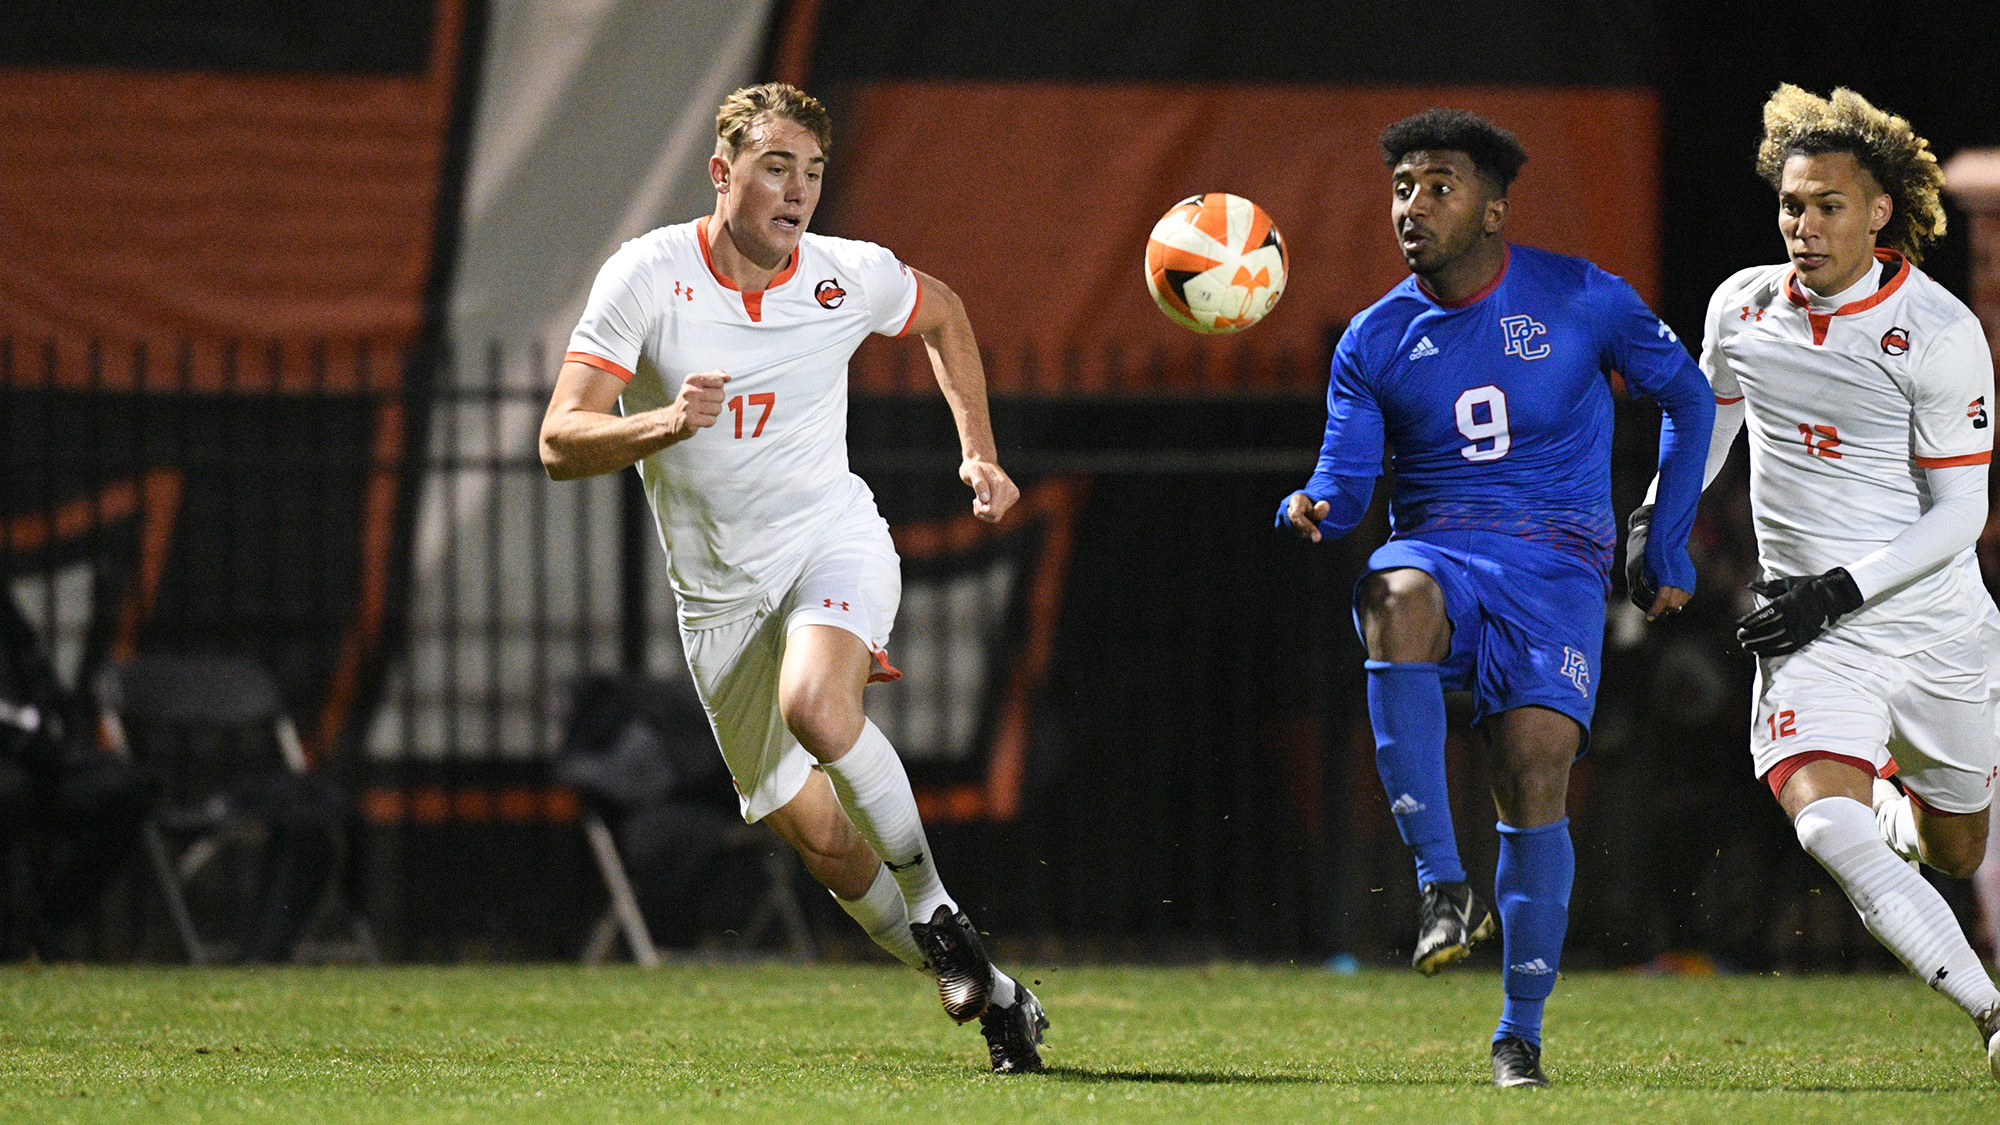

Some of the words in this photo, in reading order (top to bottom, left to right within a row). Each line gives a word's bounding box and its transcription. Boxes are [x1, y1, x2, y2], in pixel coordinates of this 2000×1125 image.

[1409, 347, 1440, 361] adidas
[1500, 314, 1550, 361] PC
[727, 392, 775, 440] 17
[1454, 383, 1511, 461] 9
[1798, 423, 1842, 460] 12
[1560, 646, 1590, 698] PC
[1767, 709, 1797, 741] 12
